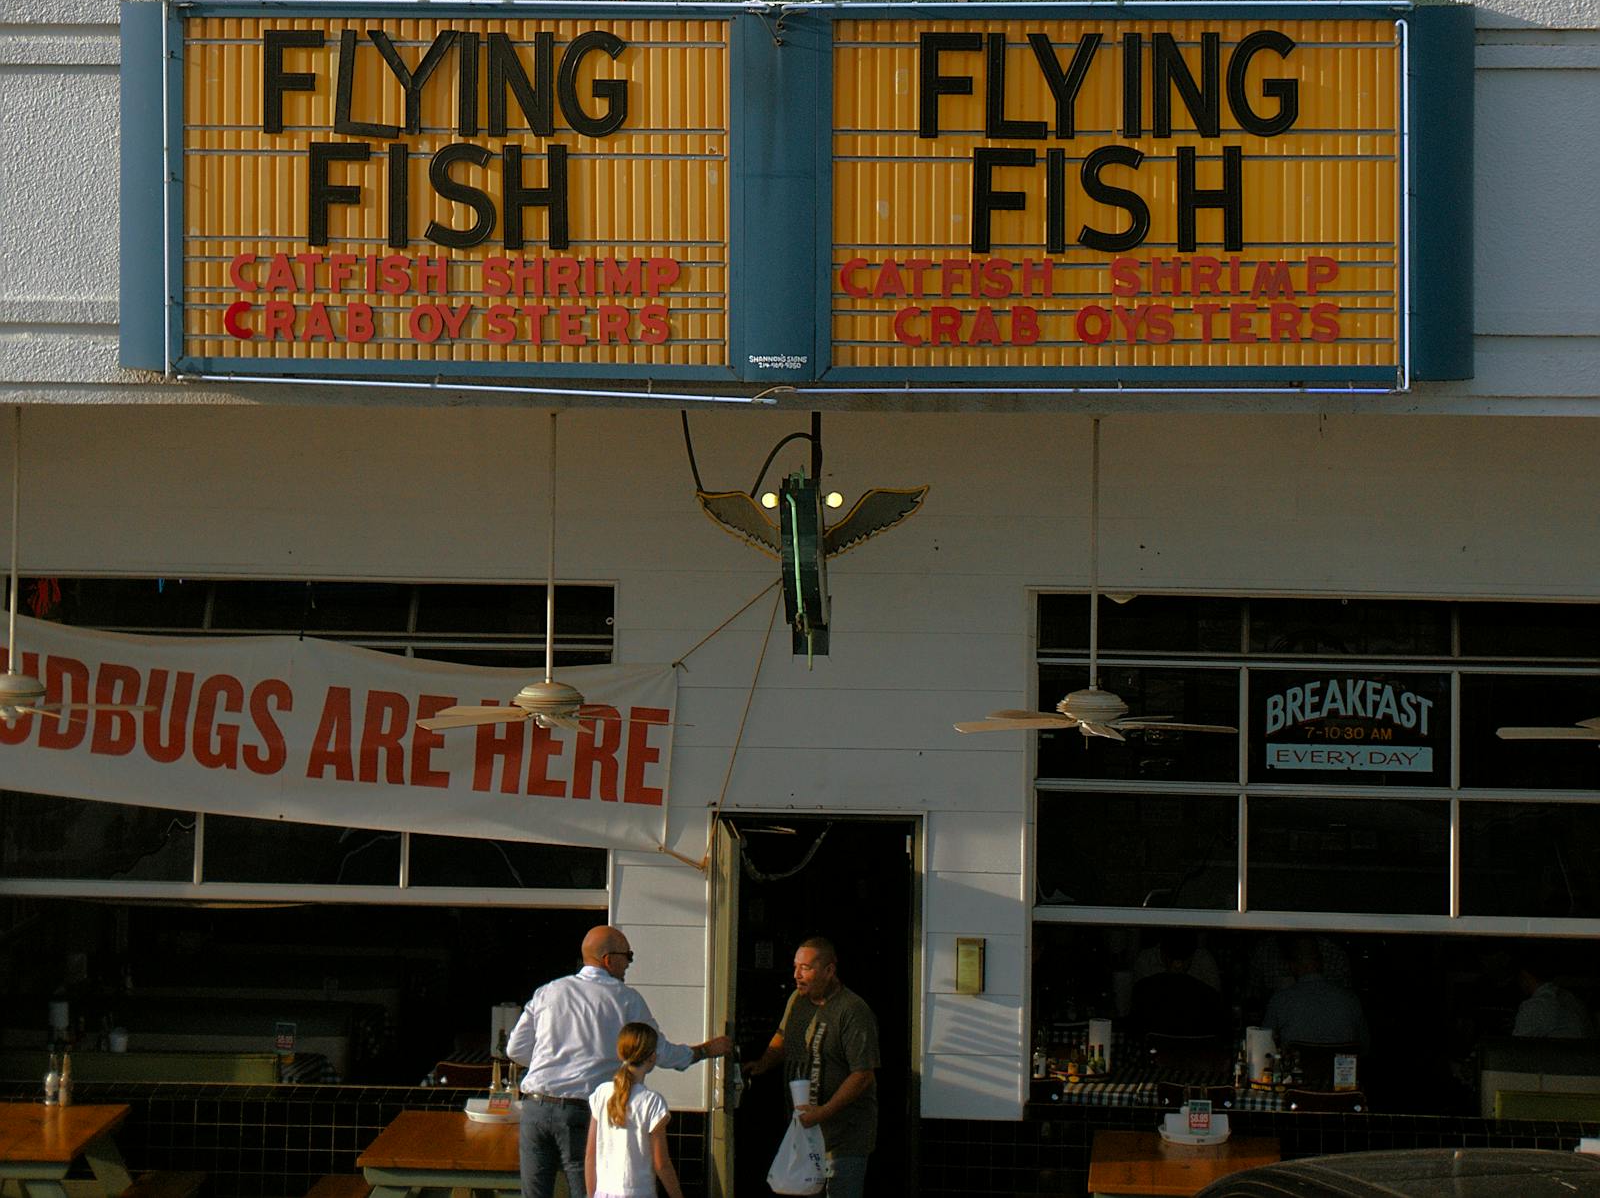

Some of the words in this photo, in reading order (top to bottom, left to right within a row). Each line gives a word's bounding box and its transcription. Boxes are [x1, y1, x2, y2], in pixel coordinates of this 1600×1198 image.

[263, 28, 629, 138] FLYING
[918, 30, 1299, 139] FLYING
[308, 142, 569, 250] FISH
[971, 145, 1243, 254] FISH
[229, 253, 449, 295] CATFISH
[483, 256, 681, 298] SHRIMP
[839, 257, 1054, 299] CATFISH
[1110, 255, 1340, 301] SHRIMP
[224, 301, 374, 344] CRAB
[408, 303, 671, 346] OYSTERS
[894, 305, 1042, 347] CRAB
[1076, 302, 1341, 345] OYSTERS
[1266, 679, 1433, 736] BREAKFAST
[306, 686, 459, 789] ARE
[472, 699, 671, 806] HERE
[1276, 749, 1362, 764] EVERY
[1368, 751, 1420, 766] DAY
[1370, 728, 1393, 741] AM
